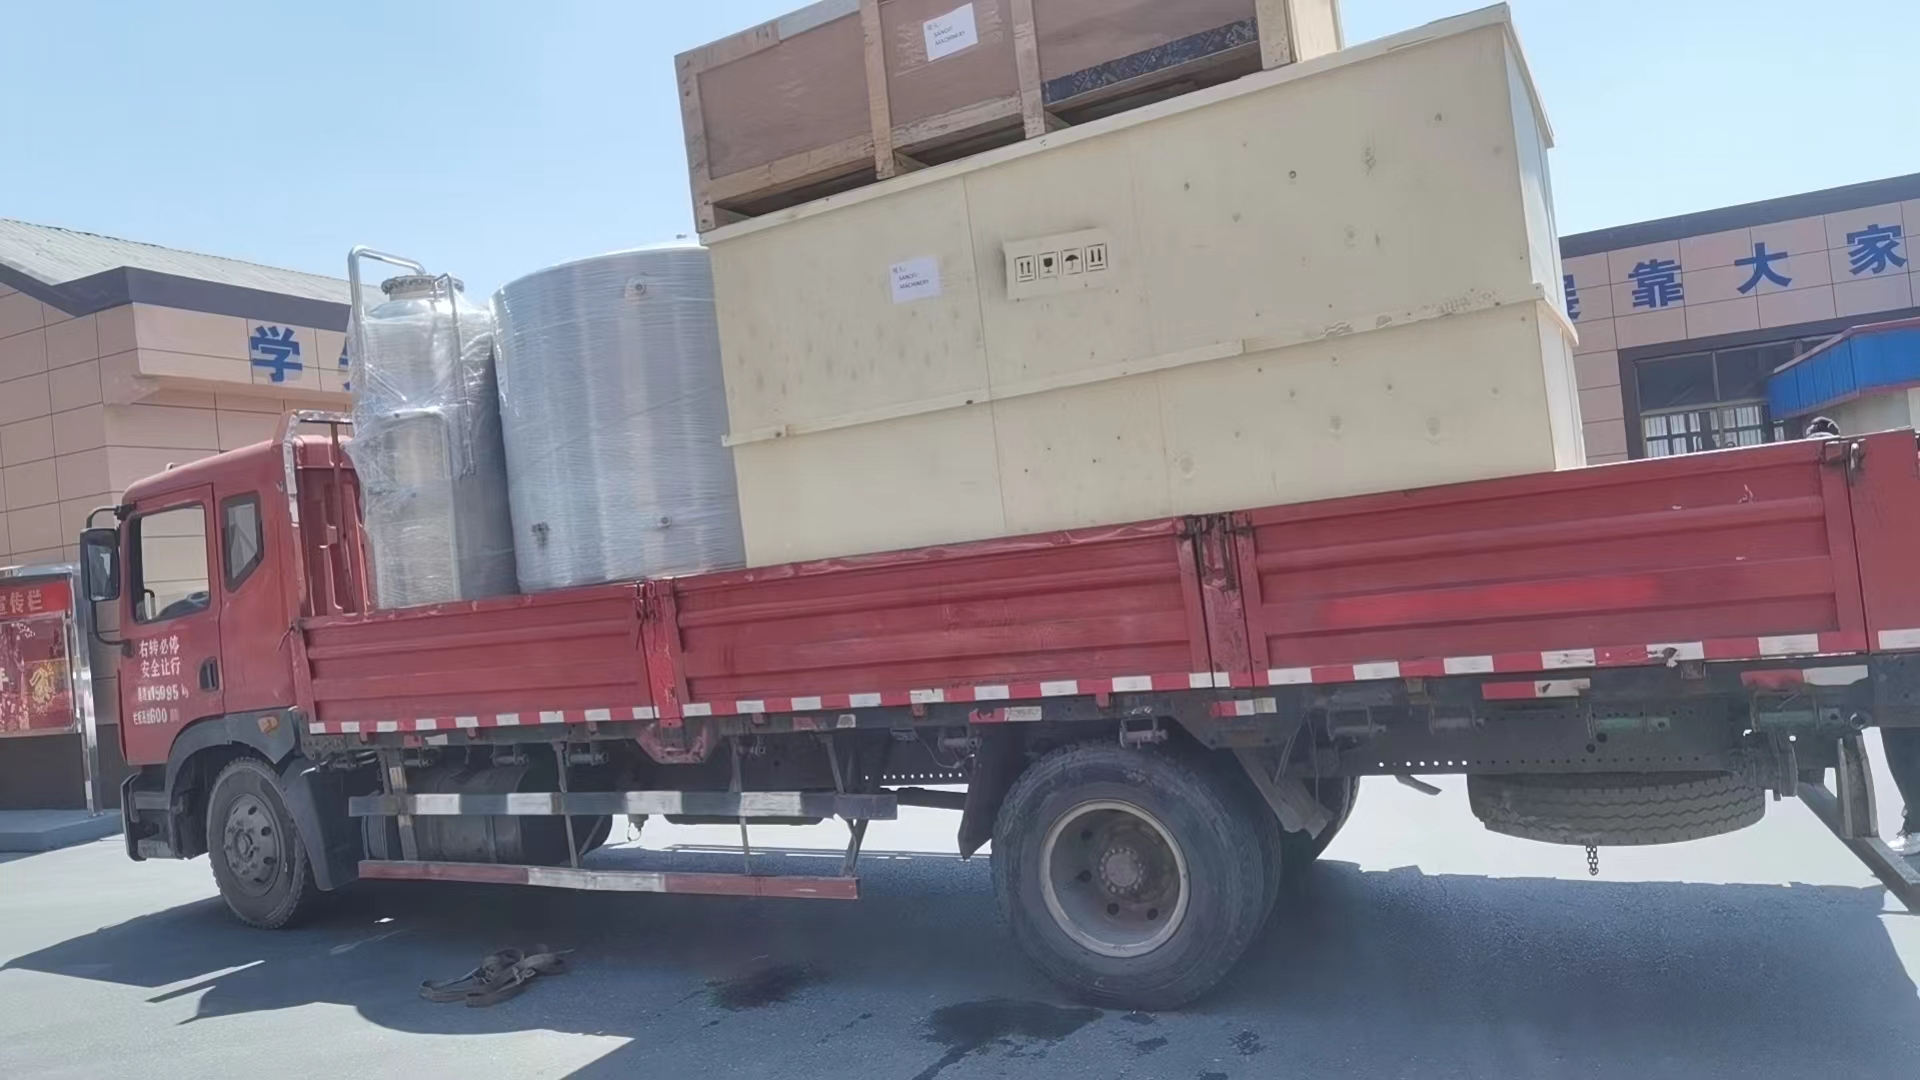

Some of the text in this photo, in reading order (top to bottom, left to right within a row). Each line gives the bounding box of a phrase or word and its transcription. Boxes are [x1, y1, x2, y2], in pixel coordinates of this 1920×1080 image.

[139, 635, 180, 658] 右转必停
[140, 656, 181, 678] 安全让行
